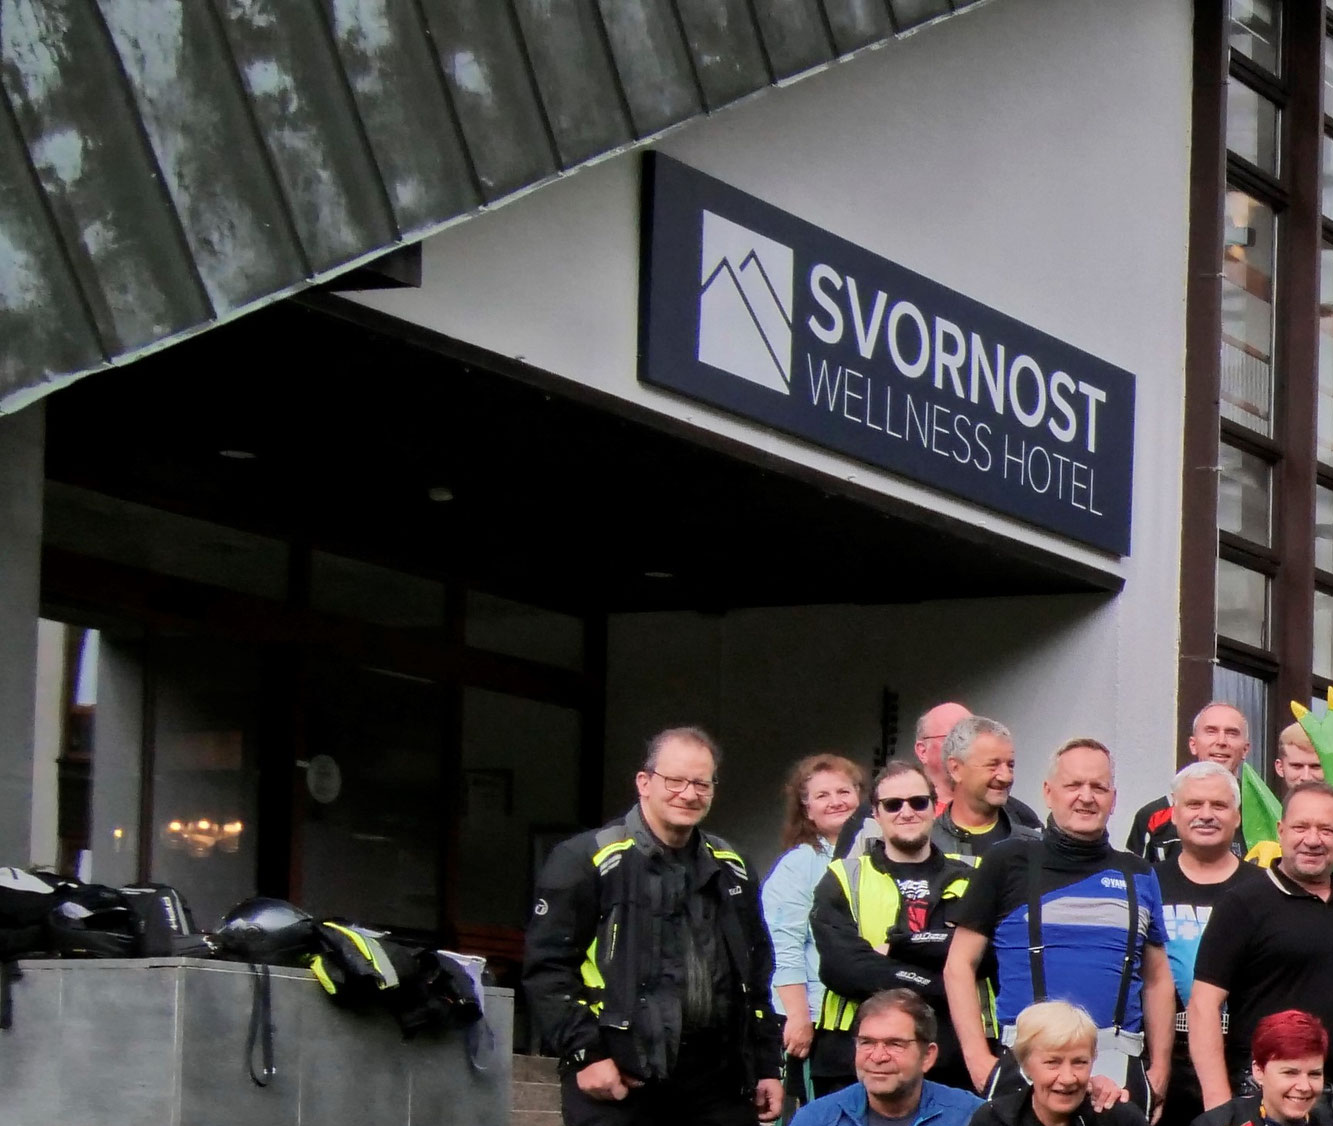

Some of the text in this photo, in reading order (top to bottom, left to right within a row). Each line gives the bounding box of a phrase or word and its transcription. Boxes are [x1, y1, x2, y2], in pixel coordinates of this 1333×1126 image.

[807, 353, 1103, 516] WELLNESS HOTEL
[808, 263, 1106, 453] SVORNOST
